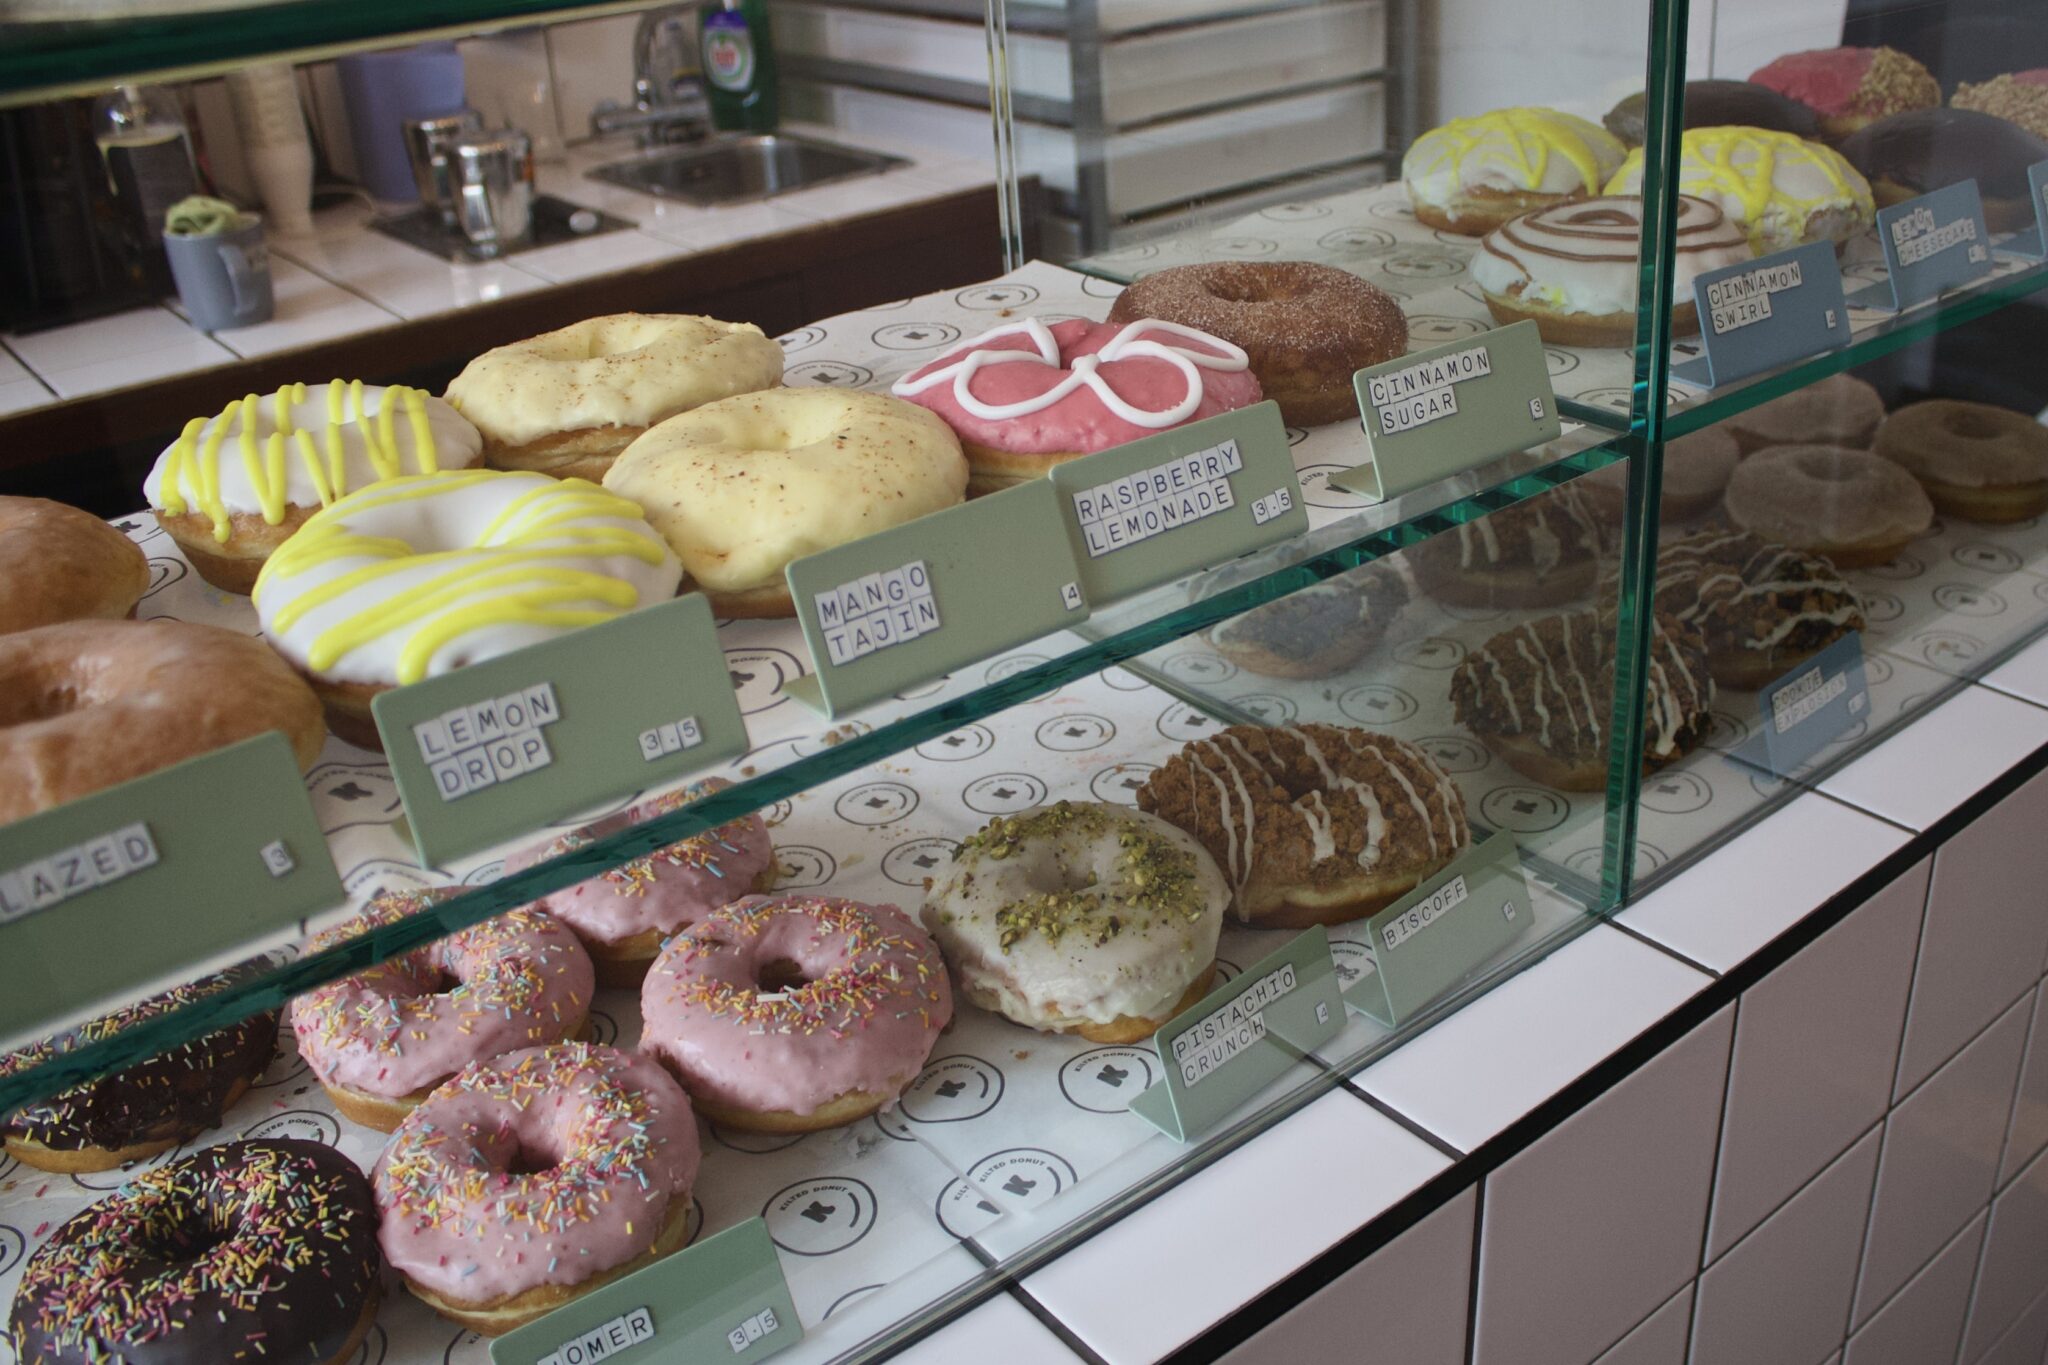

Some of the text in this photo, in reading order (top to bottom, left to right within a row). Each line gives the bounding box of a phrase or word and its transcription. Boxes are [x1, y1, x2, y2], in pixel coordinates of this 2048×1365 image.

[1710, 265, 1799, 305] CINNAMON
[1715, 300, 1769, 329] SWIRL
[1373, 352, 1488, 401] CINNAMON
[1383, 392, 1453, 430] SUGAR
[1080, 446, 1236, 519] RASPBERRY
[1255, 492, 1290, 516] 3.5
[1090, 484, 1229, 551] LEMONADE
[822, 566, 925, 623] MANGO
[830, 602, 935, 657] TAJIN
[423, 693, 550, 755] LEMON
[644, 723, 696, 750] 3.5
[440, 738, 541, 793] DROP
[1385, 881, 1464, 945] BISCOFF
[1175, 971, 1293, 1058] PISTACHIO
[943, 1063, 975, 1071] DONUT
[1075, 1055, 1099, 1072] KILTED
[1185, 1017, 1264, 1082] CRUNCH
[257, 1118, 319, 1138] ILTED DONUT
[980, 1157, 1046, 1183] KILTED DONUT
[780, 1185, 848, 1211] KILTED DONUT
[954, 1185, 970, 1201] KILT
[551, 1313, 776, 1365] OMER 3.5
